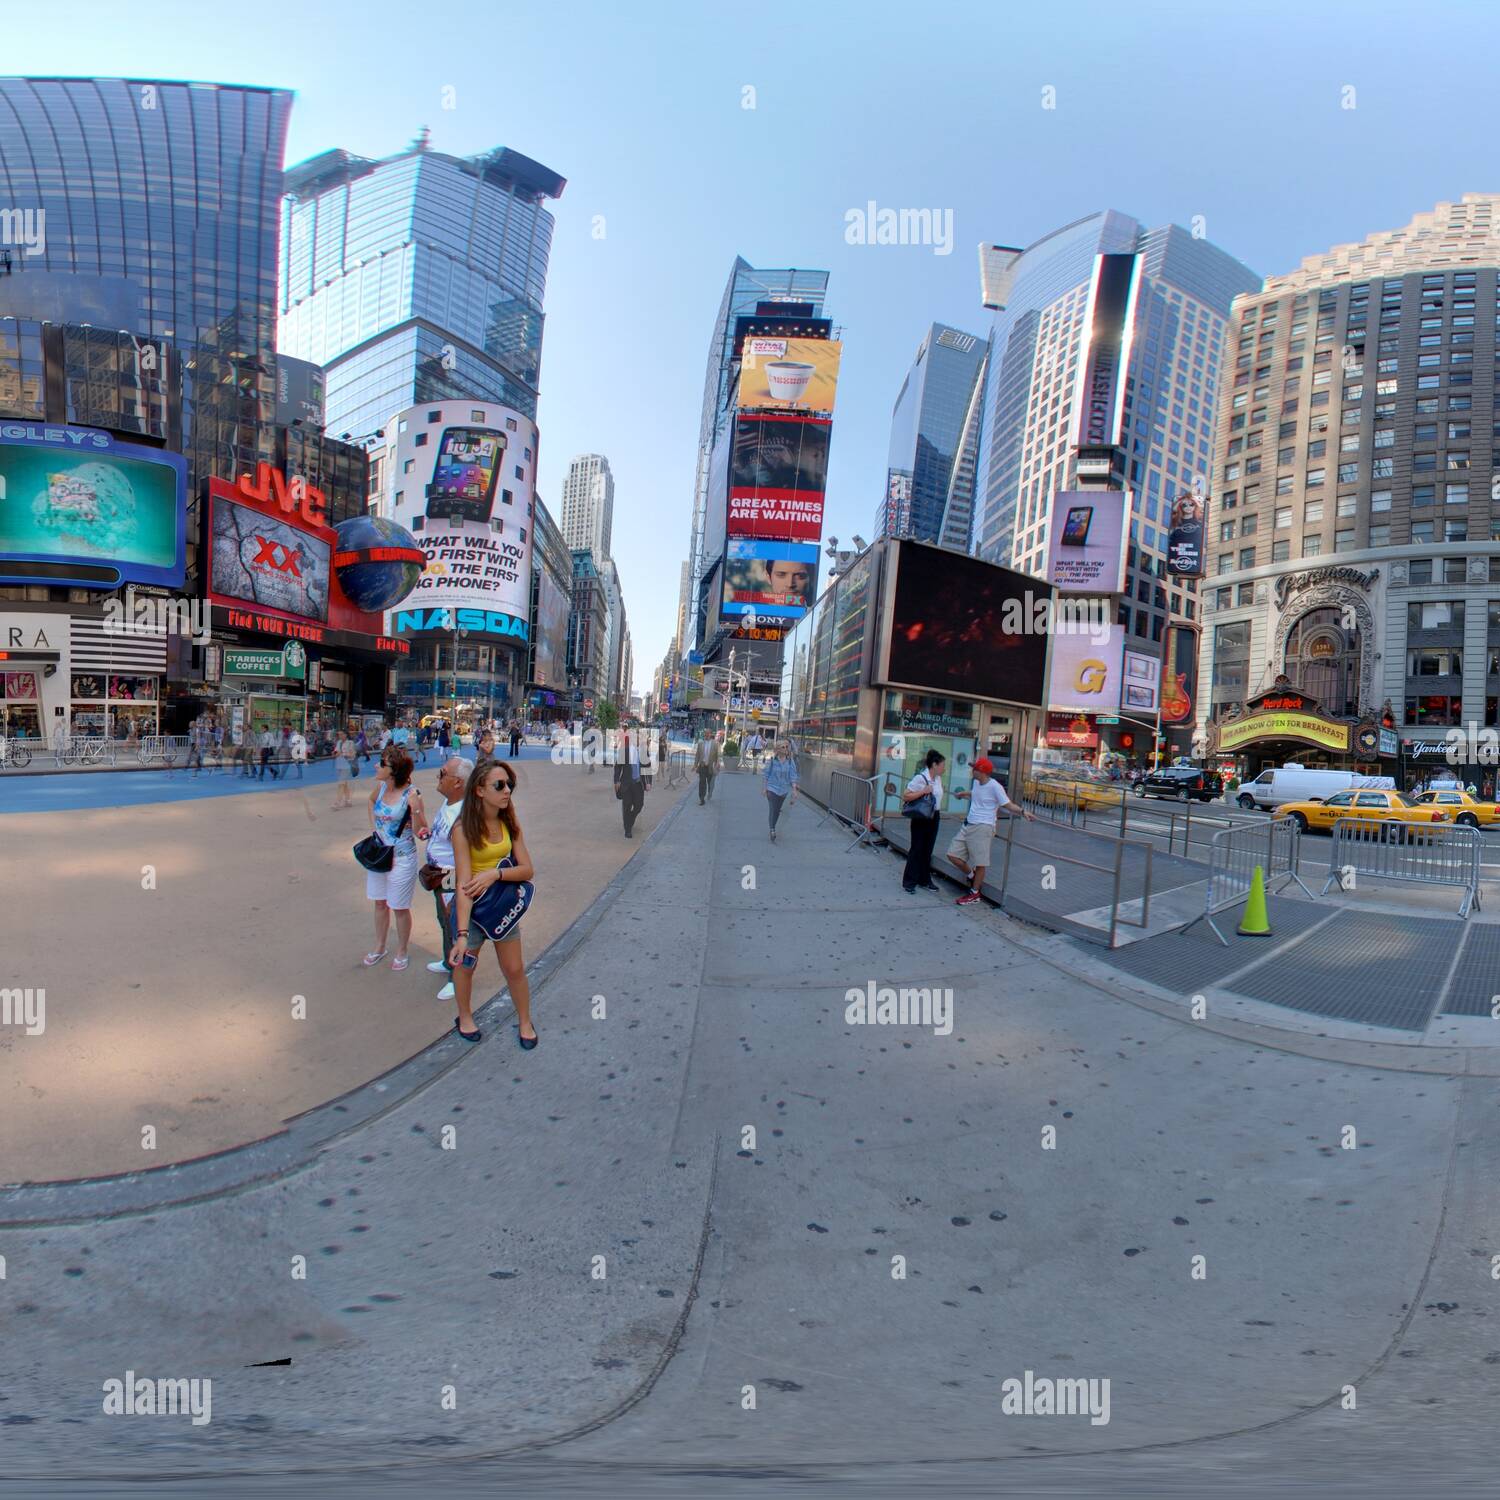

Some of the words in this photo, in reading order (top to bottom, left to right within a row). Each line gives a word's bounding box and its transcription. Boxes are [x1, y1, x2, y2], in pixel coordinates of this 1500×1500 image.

[240, 460, 325, 528] JVC
[731, 498, 776, 509] GREAT
[780, 500, 822, 512] TIMES
[730, 509, 758, 519] ARE
[763, 510, 821, 523] WAITING
[252, 534, 303, 578] XX
[416, 536, 460, 548] WHAT
[464, 537, 499, 551] WILL
[502, 542, 523, 559] YOU
[440, 549, 484, 561] FIRST
[488, 552, 517, 569] WITH
[451, 563, 481, 575] THE
[485, 567, 519, 583] FIRST
[436, 577, 500, 591] PHONE?
[1274, 566, 1380, 612] Paramount
[228, 608, 253, 628] Find
[748, 615, 786, 624] SONY
[226, 653, 280, 664] STARBUCKS
[236, 663, 271, 671] COFFEE
[1248, 721, 1266, 731] NOW
[1267, 720, 1286, 728] OPEN
[1287, 720, 1301, 728] FOR
[1302, 721, 1345, 740] BREAKFAST
[1413, 741, 1457, 759] Yankees
[495, 897, 525, 935] adidas
